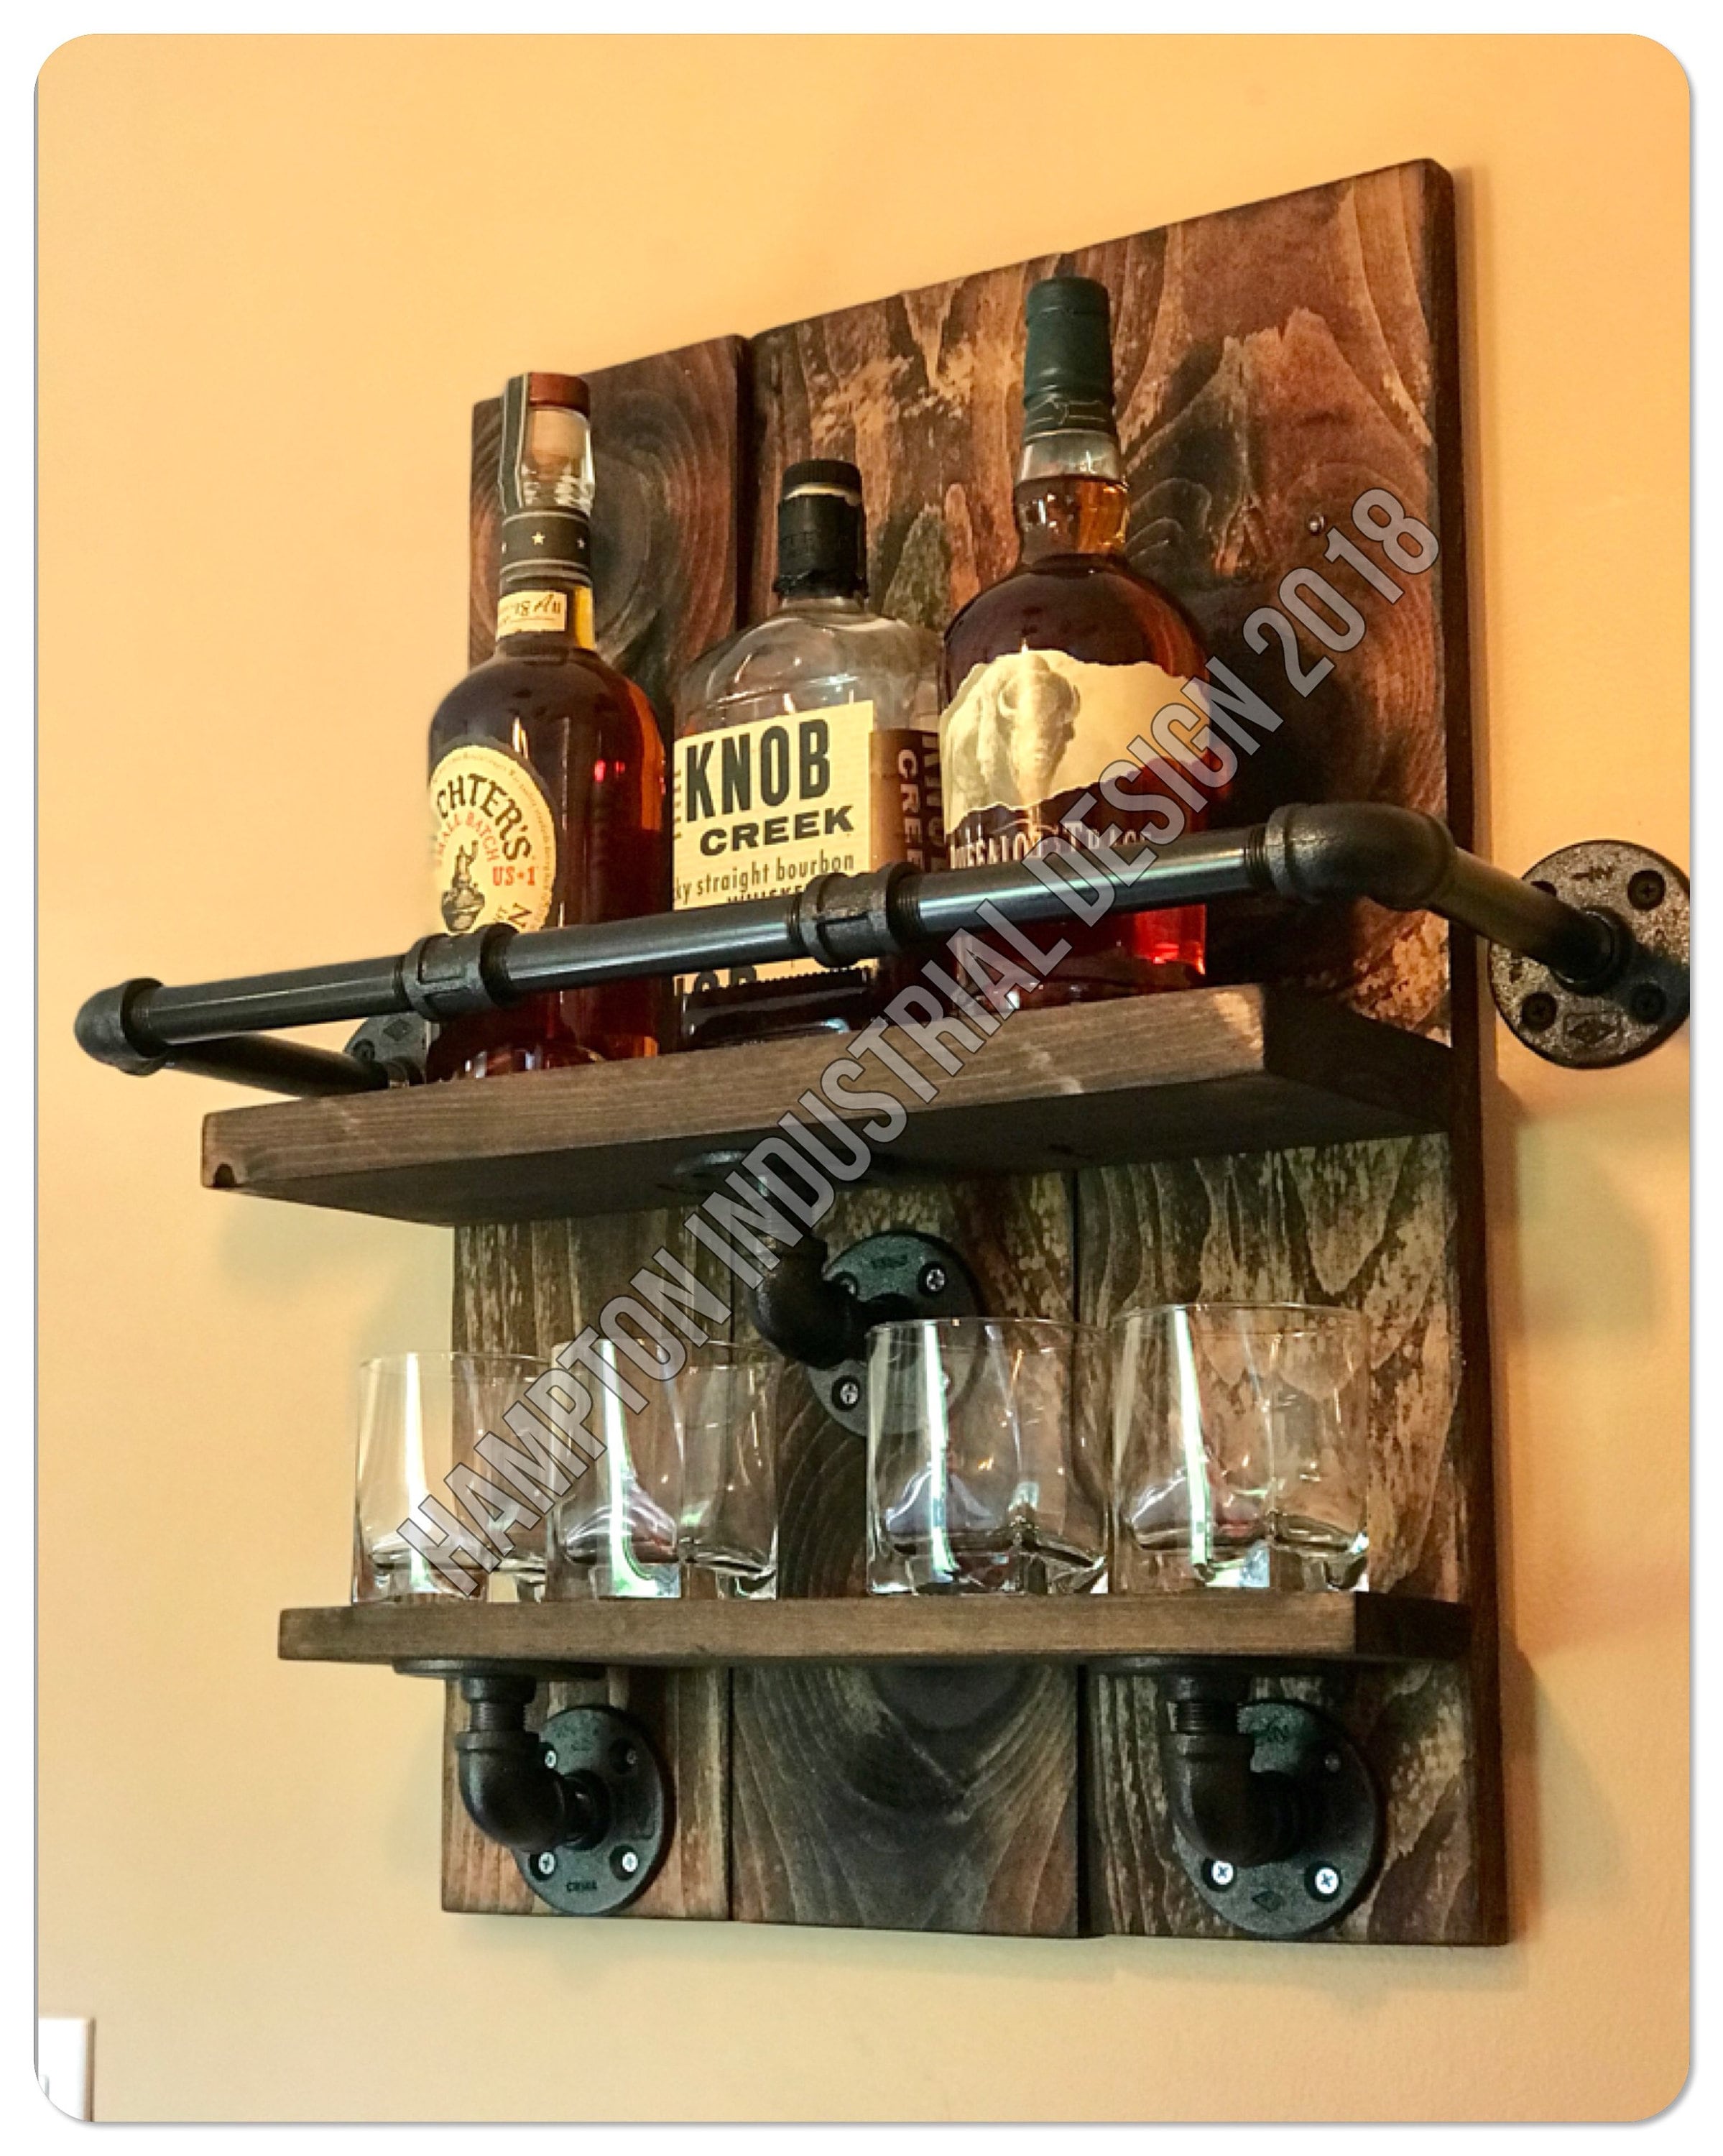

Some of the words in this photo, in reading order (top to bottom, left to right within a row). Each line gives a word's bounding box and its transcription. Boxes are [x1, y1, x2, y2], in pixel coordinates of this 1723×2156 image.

[686, 719, 831, 822] KNOB
[699, 805, 854, 856] CREEK
[696, 860, 770, 896] straight
[776, 849, 854, 880] bourbon
